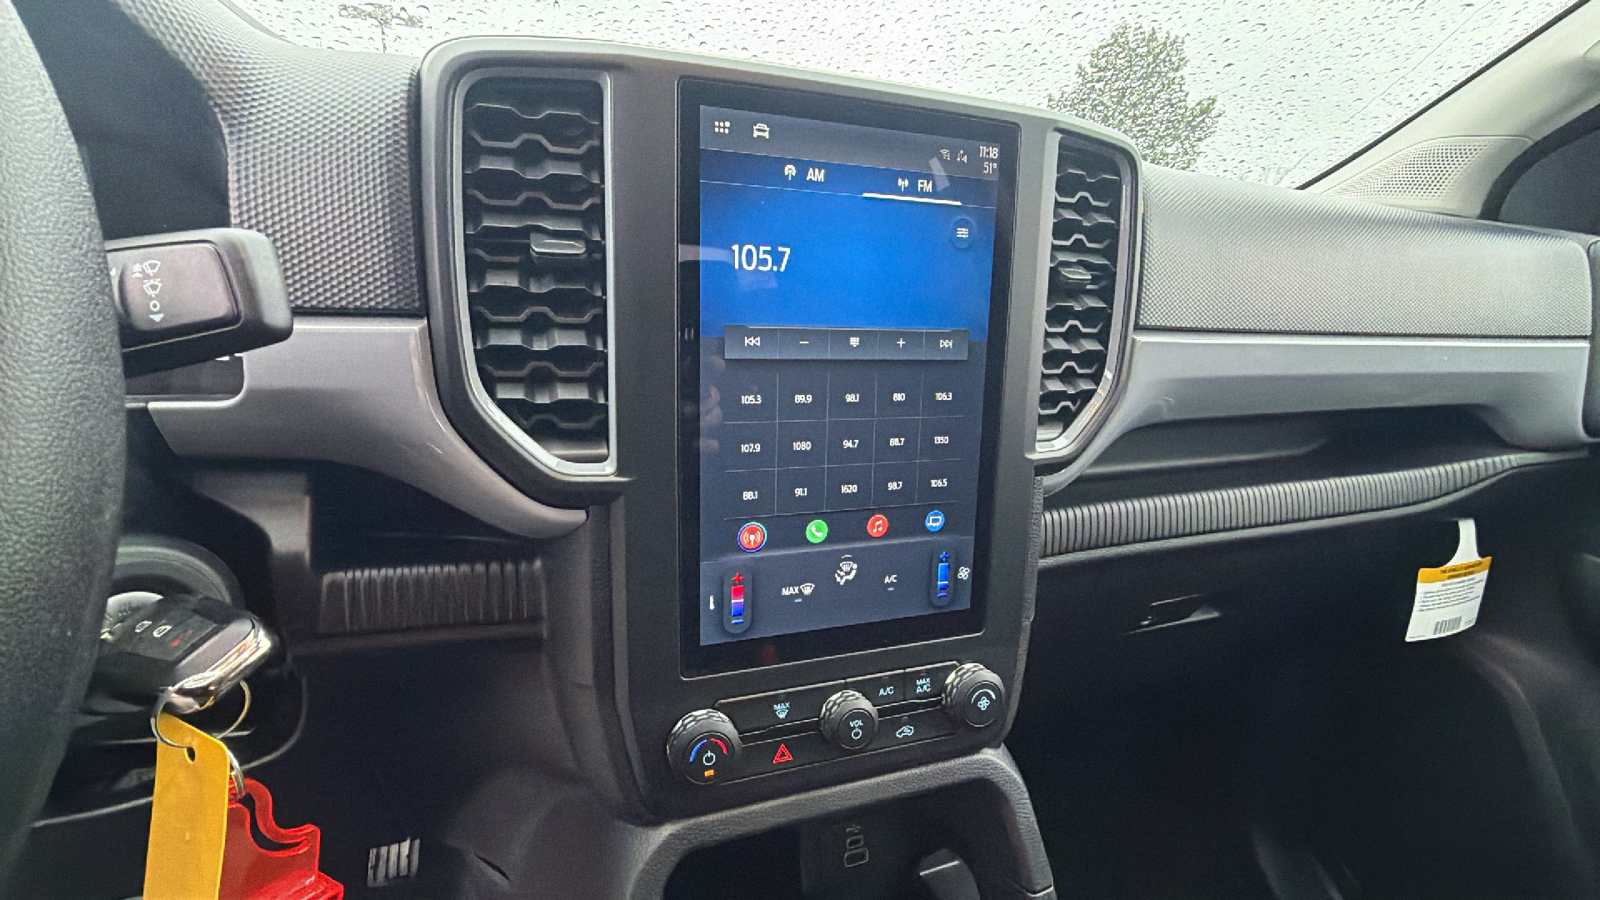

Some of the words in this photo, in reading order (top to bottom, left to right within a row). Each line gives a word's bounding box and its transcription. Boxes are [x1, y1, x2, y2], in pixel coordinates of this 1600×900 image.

[980, 145, 999, 159] 11:18
[806, 168, 825, 182] AM
[917, 179, 933, 193] FM
[731, 244, 791, 272] 105.7
[741, 394, 762, 404] 105.3
[794, 394, 812, 404] 89.9
[845, 393, 860, 403] 98.1
[842, 439, 859, 449] 94.7
[934, 436, 949, 445] 1350
[740, 443, 761, 453] 107.9
[792, 441, 812, 451] 1080
[930, 478, 948, 488] 106.5
[794, 487, 808, 497] 91.1
[841, 484, 858, 494] 1620
[884, 574, 898, 584] A/C
[781, 586, 800, 596] MAX
[916, 677, 931, 686] MAX
[878, 686, 895, 697] A/C
[916, 684, 931, 694] A/C
[773, 701, 790, 711] MAX
[850, 719, 864, 728] VOL
